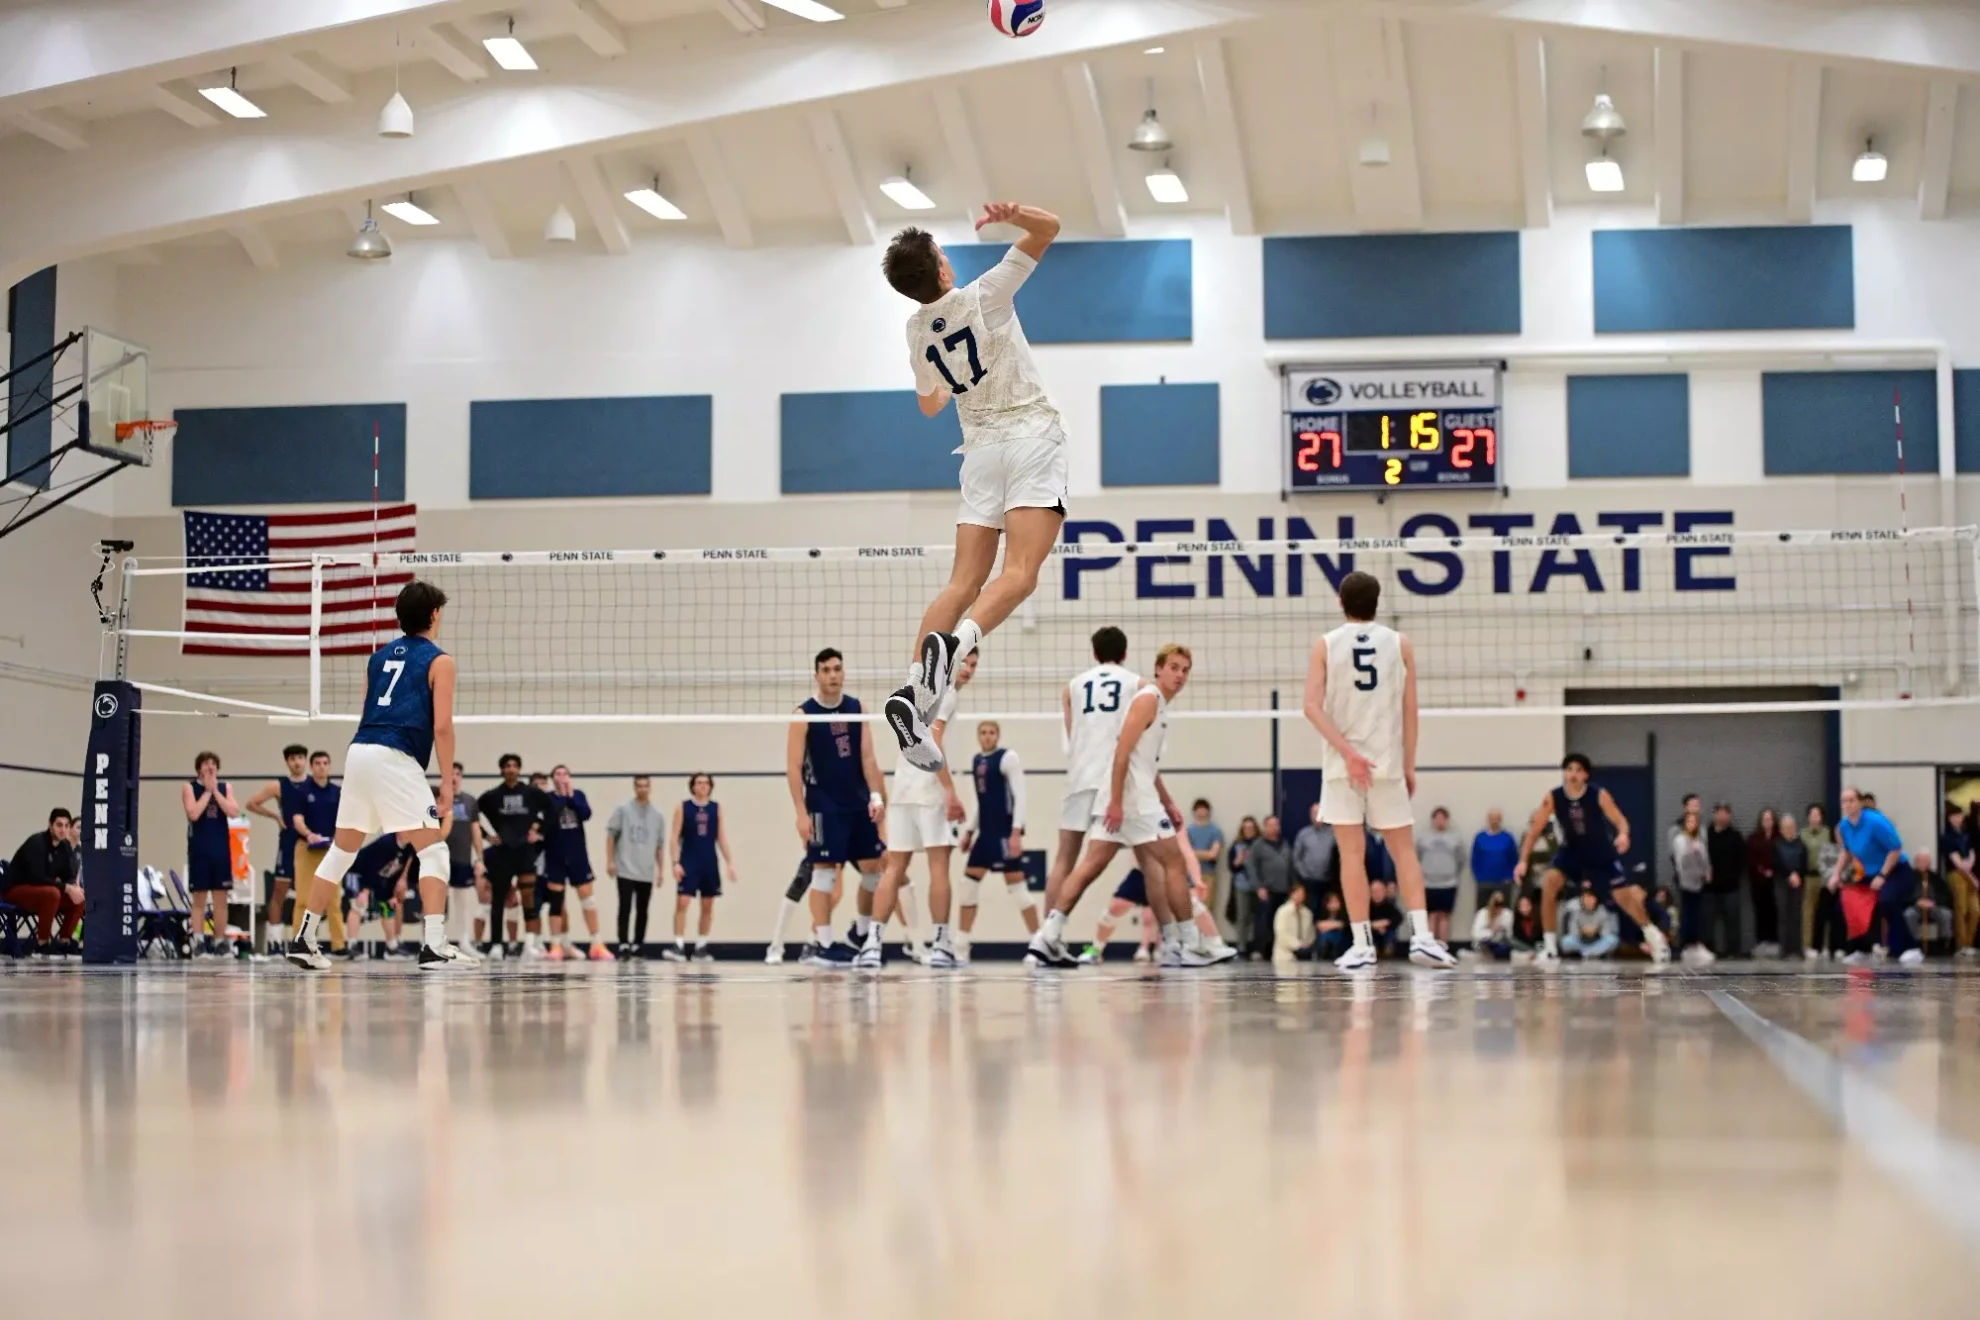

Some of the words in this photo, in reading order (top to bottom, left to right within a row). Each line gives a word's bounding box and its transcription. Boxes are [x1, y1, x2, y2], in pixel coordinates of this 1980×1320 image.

[925, 326, 988, 394] 17
[1349, 381, 1486, 399] VOLLEYBALL
[1293, 417, 1339, 432] HOME
[1444, 413, 1496, 429] GUEST
[1297, 432, 1341, 471] 27
[1451, 428, 1496, 468] 27
[1384, 458, 1403, 485] 2
[1501, 537, 1533, 546] PENN
[1536, 537, 1569, 545] STATE
[1666, 535, 1697, 544] PENN
[1700, 534, 1735, 543] STATE
[1831, 532, 1862, 540] PENN
[1865, 531, 1900, 539] STATE
[858, 548, 888, 557] PENN
[891, 547, 924, 557] STATE
[1177, 543, 1208, 552] PENN
[1211, 542, 1244, 551] STATE
[1339, 540, 1369, 549] PENN
[1372, 539, 1406, 549] STATE
[400, 554, 428, 564] PENN
[431, 553, 462, 563] STATE
[549, 551, 578, 561] PENN
[581, 550, 613, 560] STATE
[703, 550, 732, 559] PENN
[735, 549, 768, 559] STATE
[1063, 515, 1355, 600] PENN
[1397, 511, 1736, 596] STATE
[1353, 648, 1378, 691] 5
[377, 660, 405, 706] 7
[1083, 681, 1122, 714] 13
[94, 753, 110, 849] PENN
